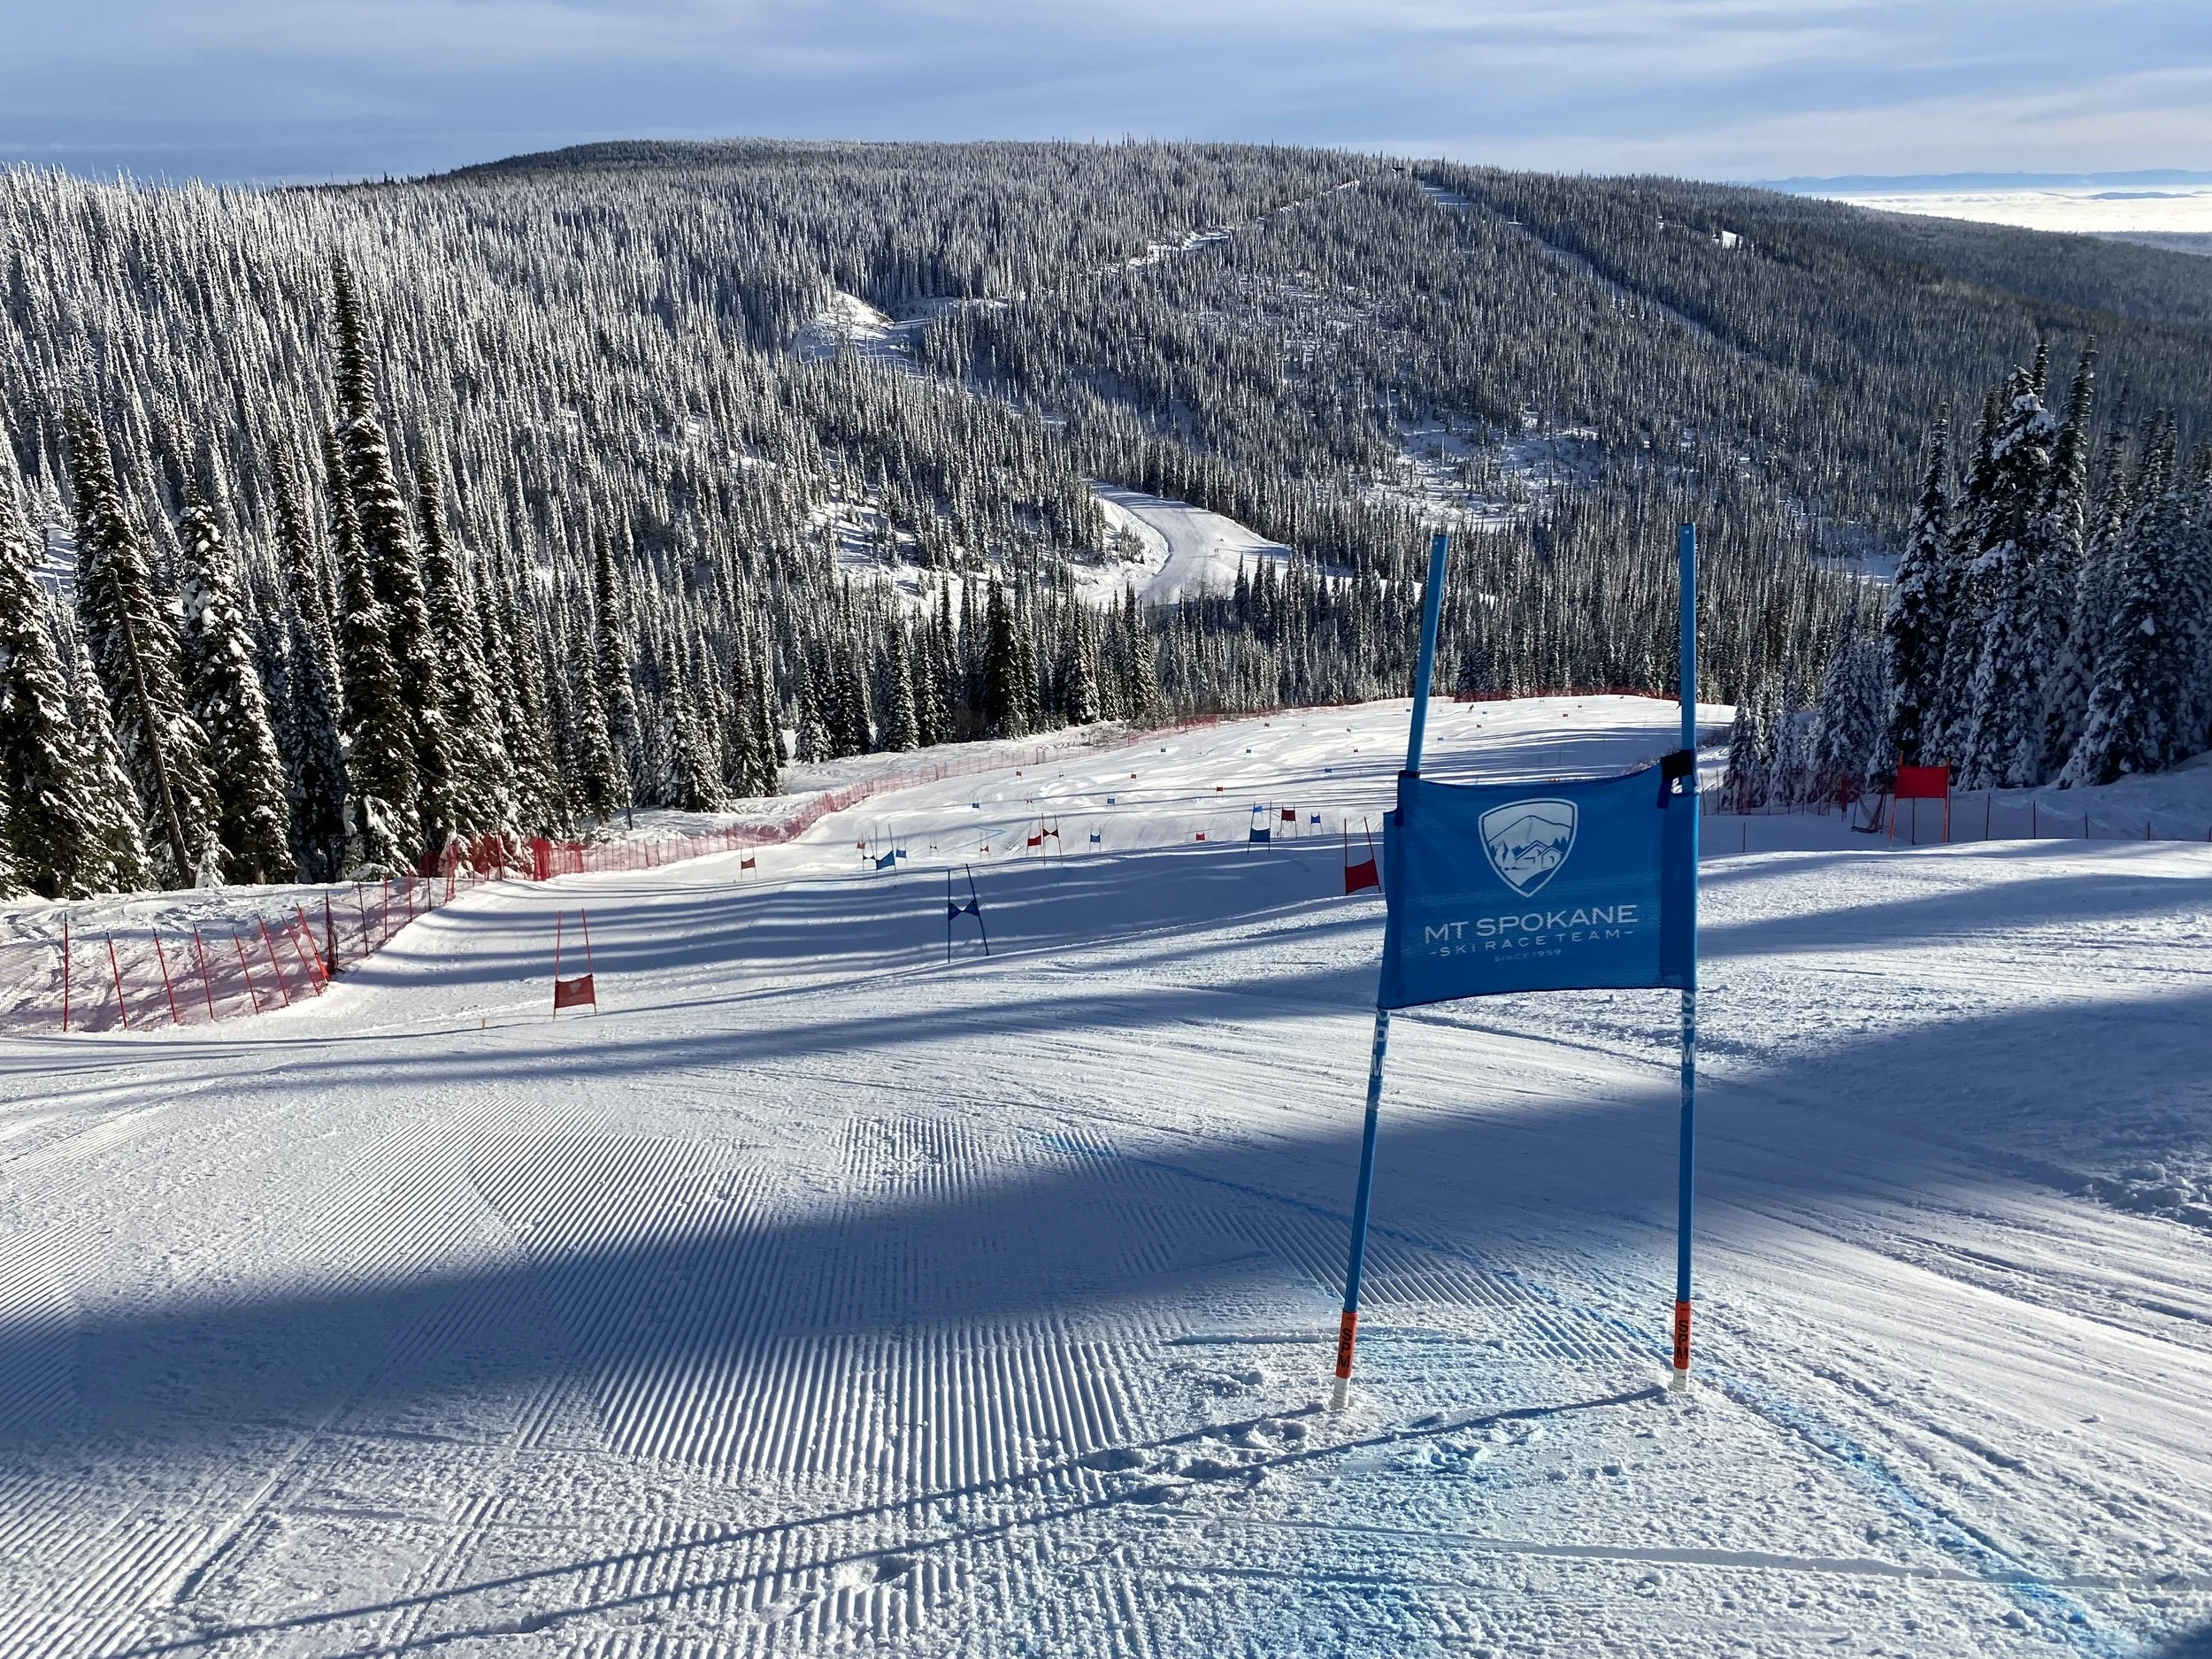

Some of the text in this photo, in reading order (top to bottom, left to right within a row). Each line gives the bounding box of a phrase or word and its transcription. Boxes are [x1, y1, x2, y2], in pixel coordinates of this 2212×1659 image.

[1425, 904, 1639, 944] MT SPOKANE
[1485, 935, 1547, 951] RACE
[1339, 1328, 1353, 1368] SPM
[1677, 1319, 1689, 1360] SPM
